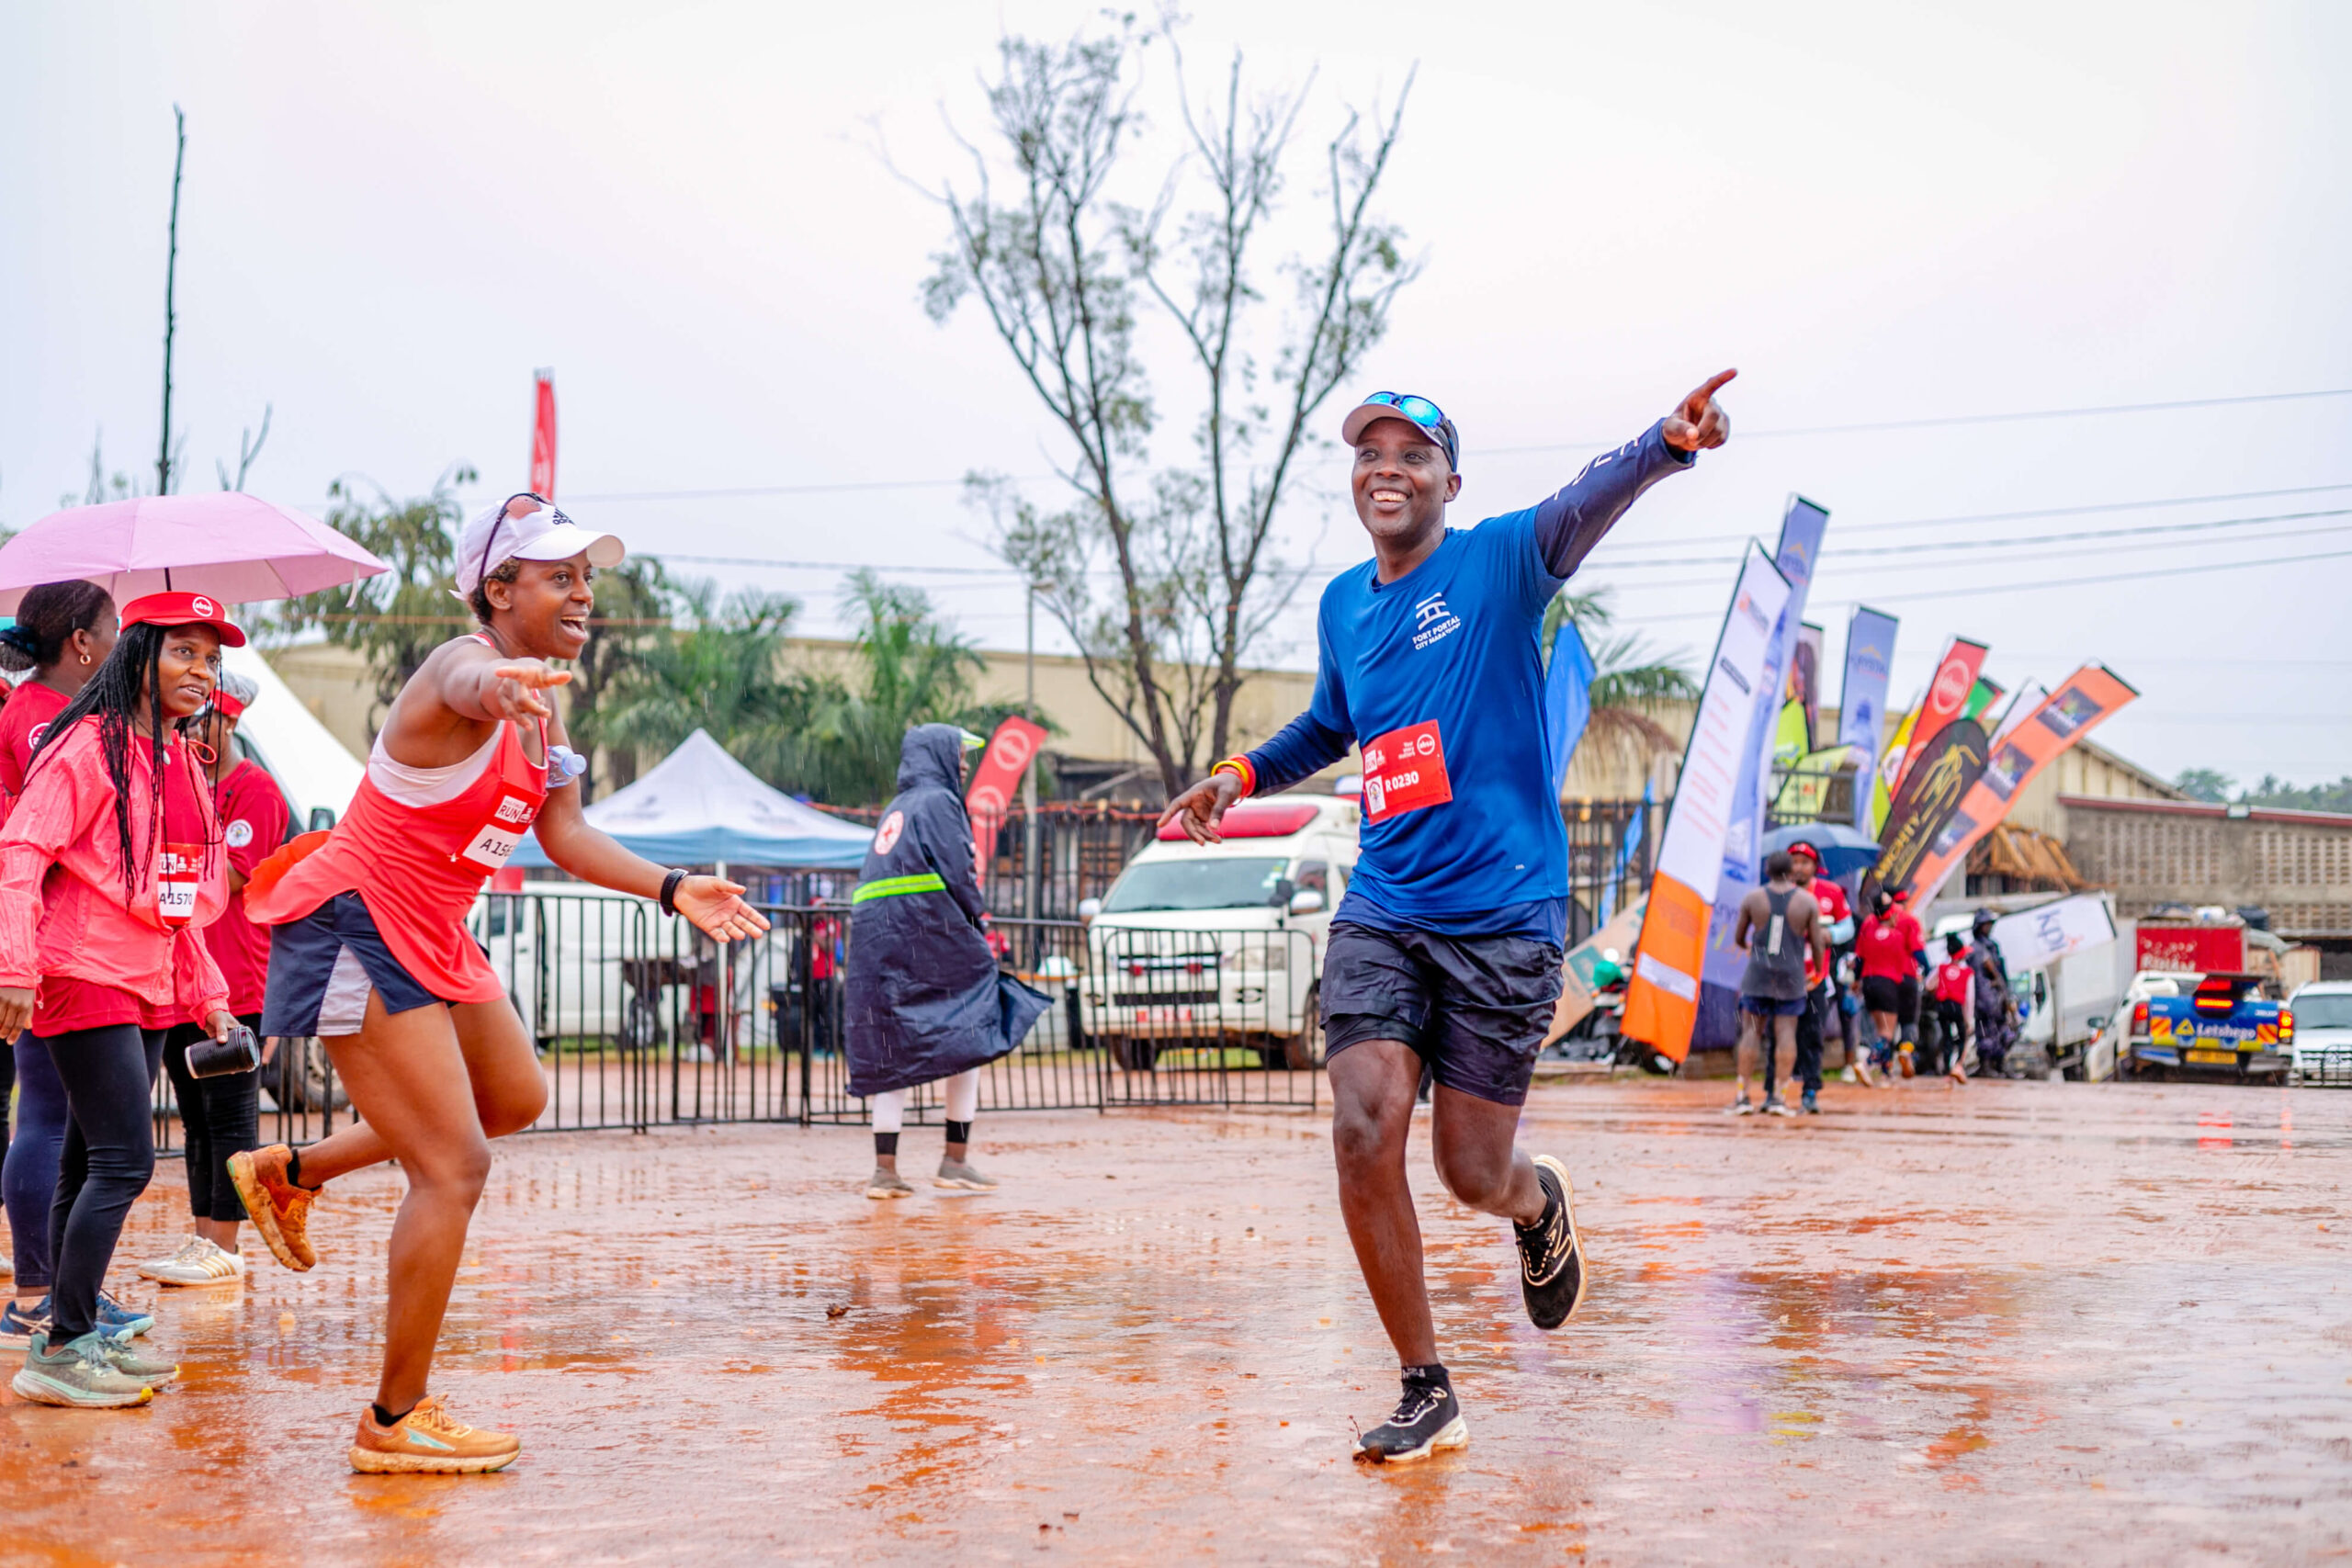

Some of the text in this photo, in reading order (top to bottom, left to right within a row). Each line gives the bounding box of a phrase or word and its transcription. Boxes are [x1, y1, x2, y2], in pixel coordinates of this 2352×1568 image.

[196, 602, 210, 612] absa
[1412, 615, 1461, 644] FORT PORTAL
[1415, 640, 1429, 650] CITY
[1419, 740, 1434, 749] absa
[498, 804, 521, 820] RUN
[1874, 810, 1920, 880] MIGHTY
[160, 860, 175, 872] UN
[2197, 1022, 2256, 1039] Letshego
